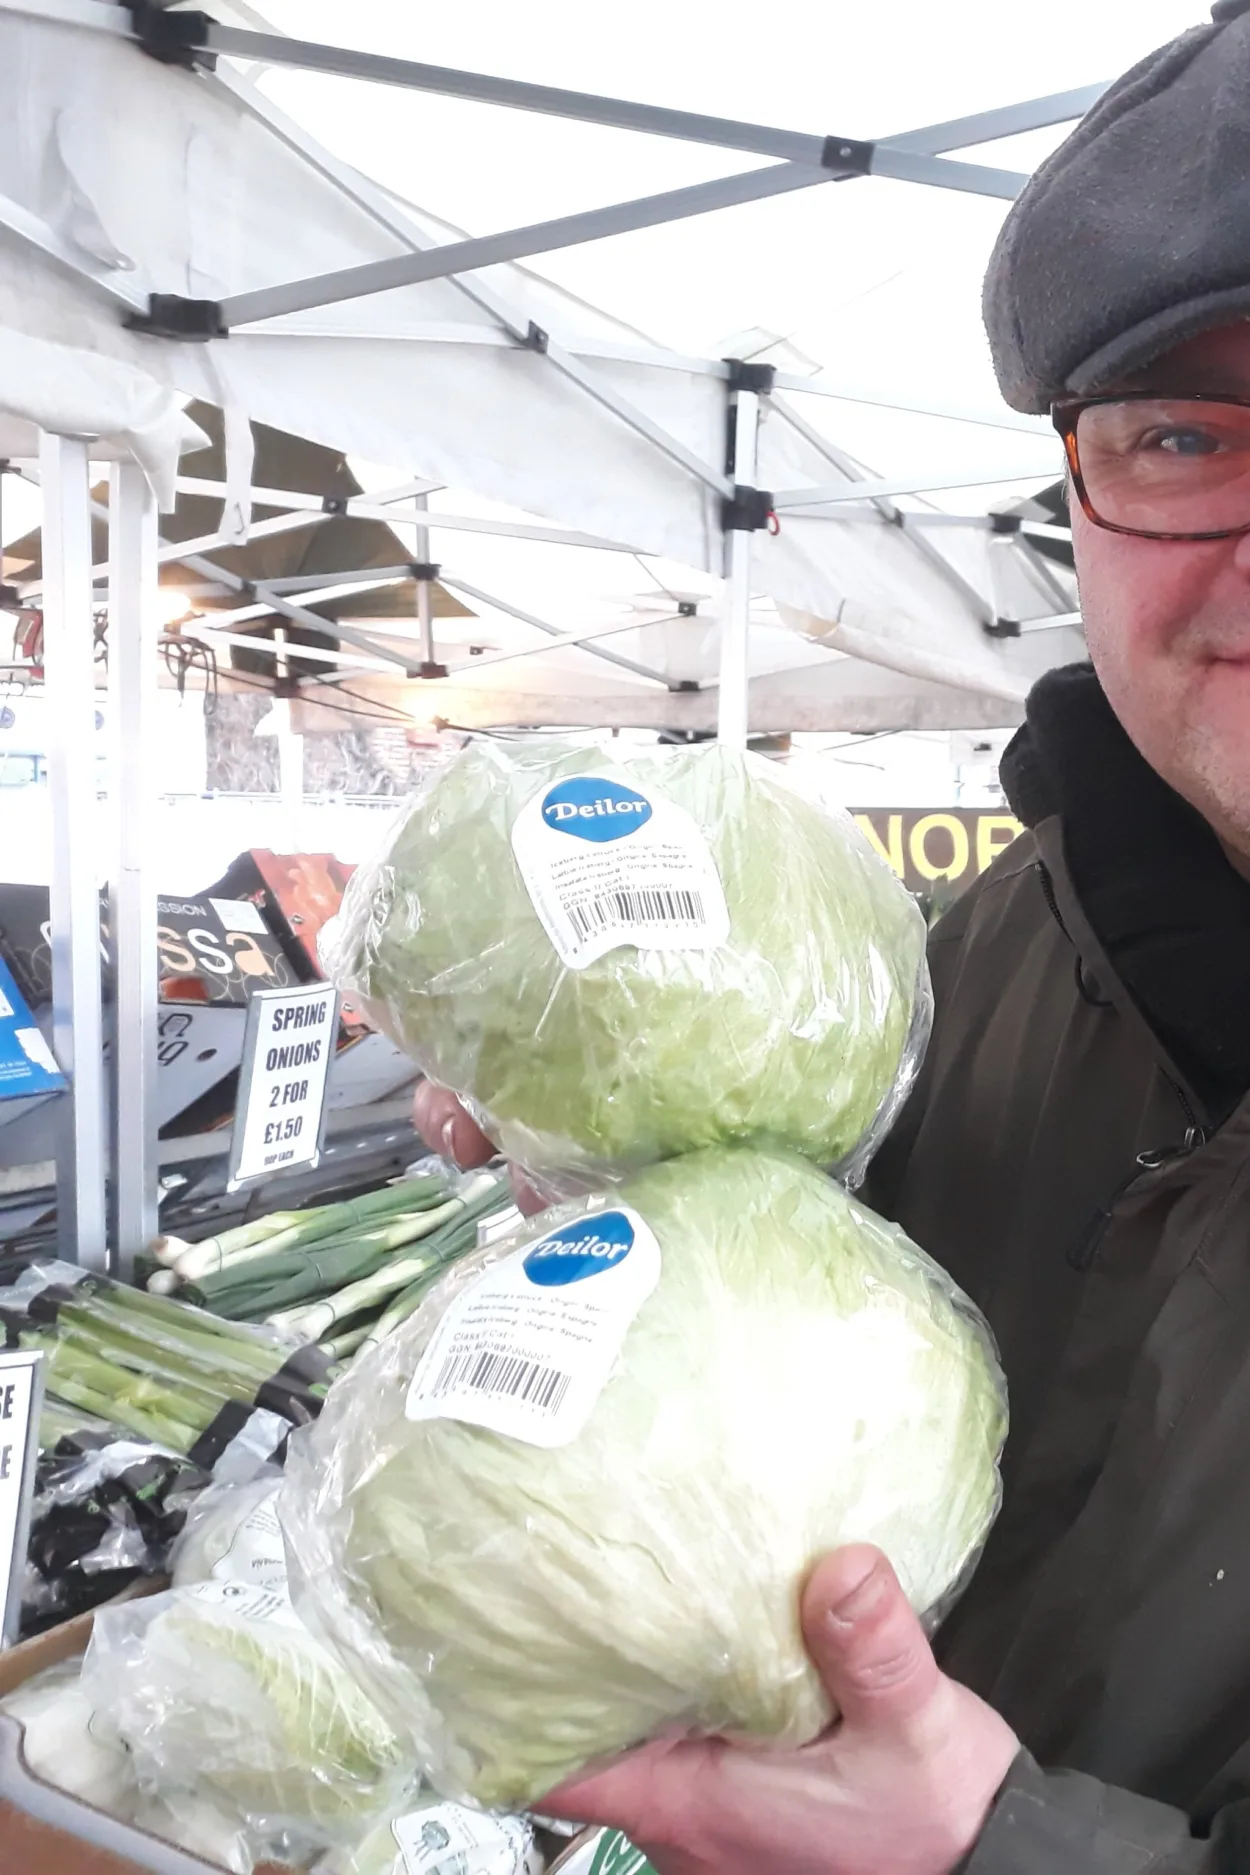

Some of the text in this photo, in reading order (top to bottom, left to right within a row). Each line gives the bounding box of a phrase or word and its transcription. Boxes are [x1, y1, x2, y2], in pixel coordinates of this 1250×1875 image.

[545, 798, 648, 821] Deilor
[271, 1001, 327, 1032] SPRING
[265, 1040, 322, 1072] ONIONS
[269, 1079, 309, 1108] 2 FOR
[263, 1115, 303, 1145] £1.50
[532, 1235, 628, 1260] Deilor
